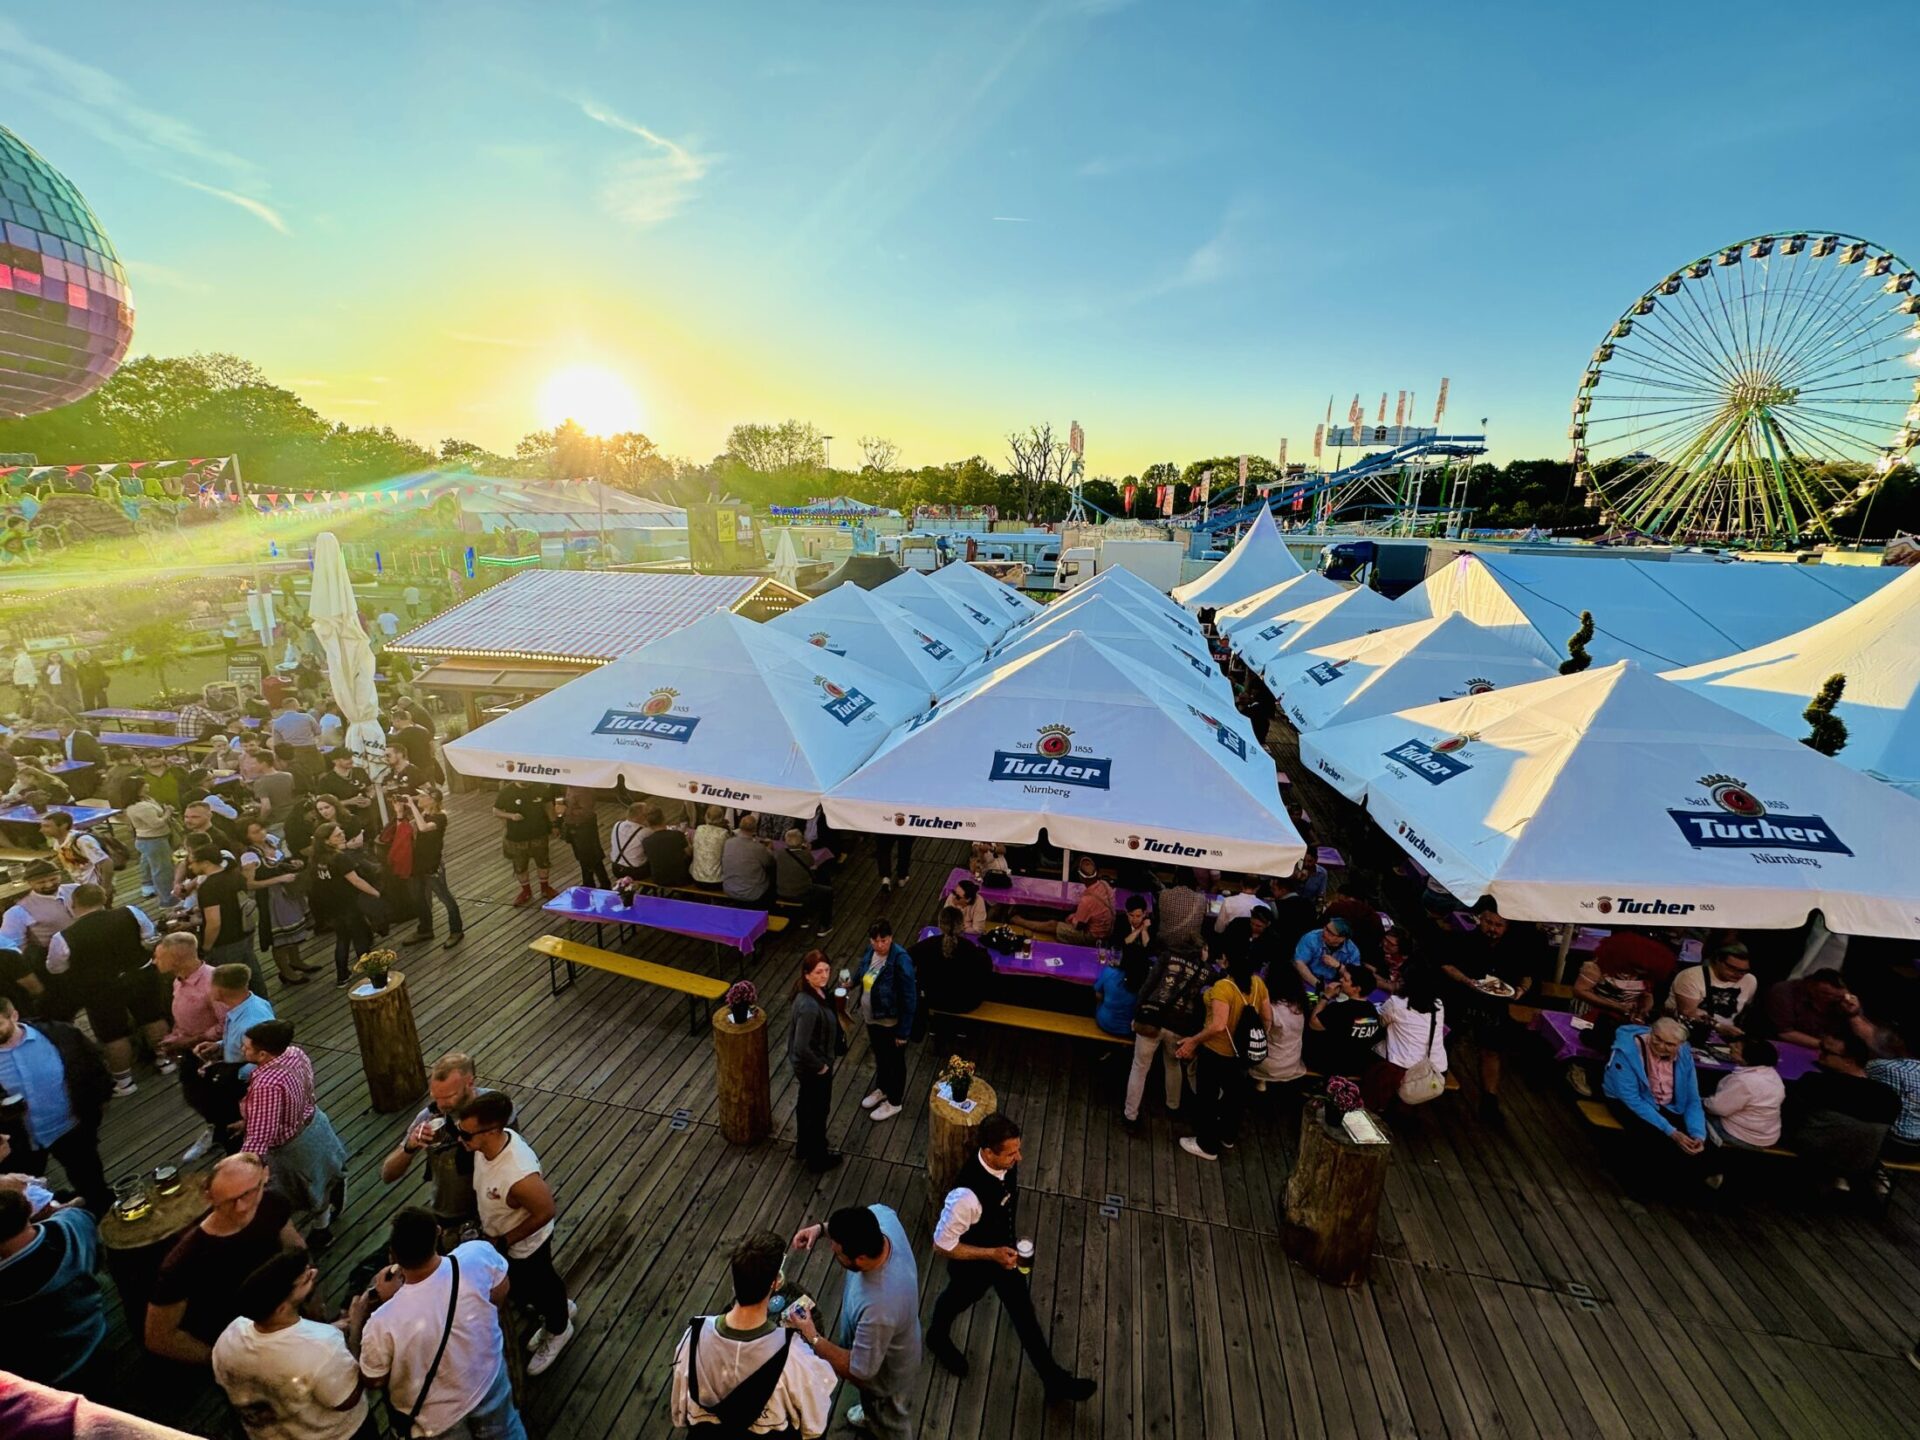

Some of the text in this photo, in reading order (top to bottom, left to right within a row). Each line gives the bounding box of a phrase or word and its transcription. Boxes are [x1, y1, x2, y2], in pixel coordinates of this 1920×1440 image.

[604, 714, 688, 735] Tucher
[1016, 741, 1093, 754] Seit 1855
[516, 761, 561, 776] Tucher
[1002, 757, 1101, 780] Tucher
[1395, 744, 1452, 775] Tucher
[700, 783, 750, 801] Tucher
[1023, 784, 1071, 799] Nürnberg
[1684, 797, 1790, 810] Seit 1855
[908, 814, 963, 830] Tucher
[1689, 817, 1828, 844] Tucher
[1143, 837, 1207, 858] Tucher
[1404, 826, 1437, 859] Tucher
[1750, 852, 1822, 869] Nürnberg
[1617, 897, 1695, 915] Tucher
